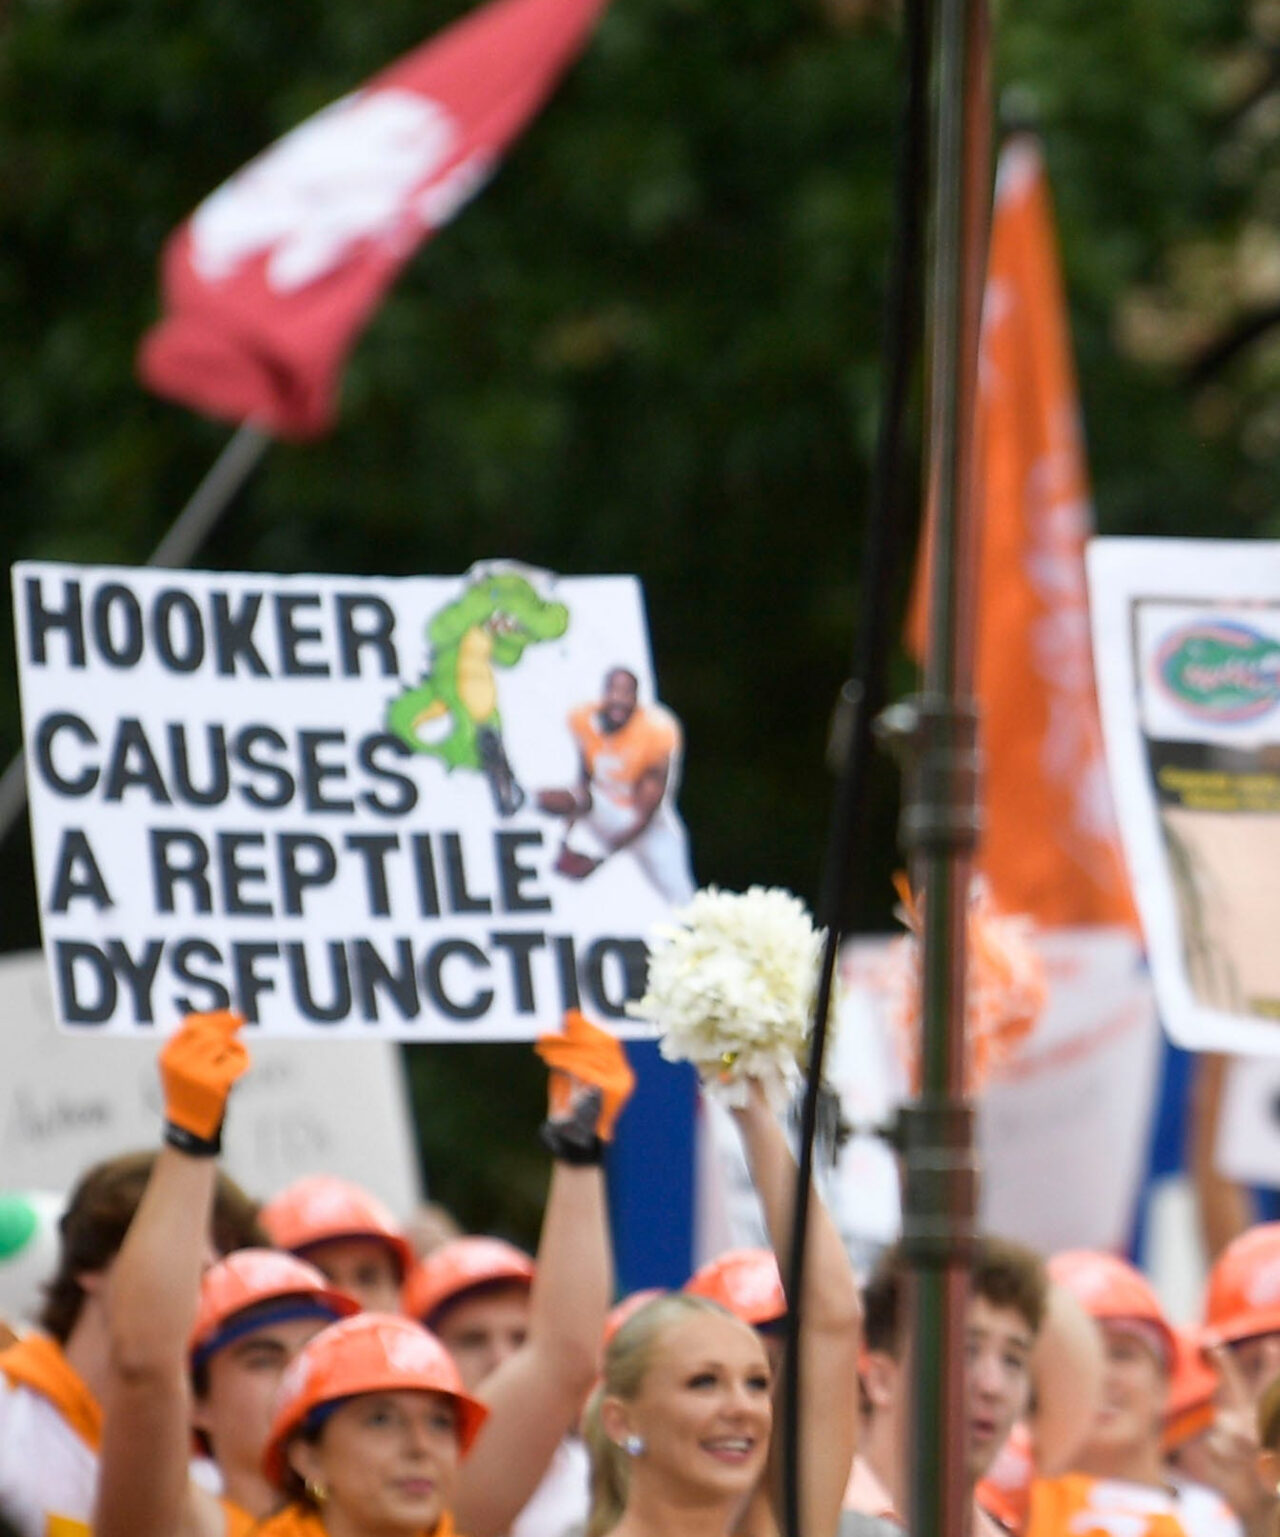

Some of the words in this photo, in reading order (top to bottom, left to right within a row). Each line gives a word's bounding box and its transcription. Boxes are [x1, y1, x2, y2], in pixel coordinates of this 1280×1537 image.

[25, 577, 401, 679] HOOKER
[35, 711, 421, 816] CAUSES
[48, 828, 115, 914] A
[149, 828, 554, 919] REPTILE
[54, 930, 653, 1026] DYSFUNCTIO
